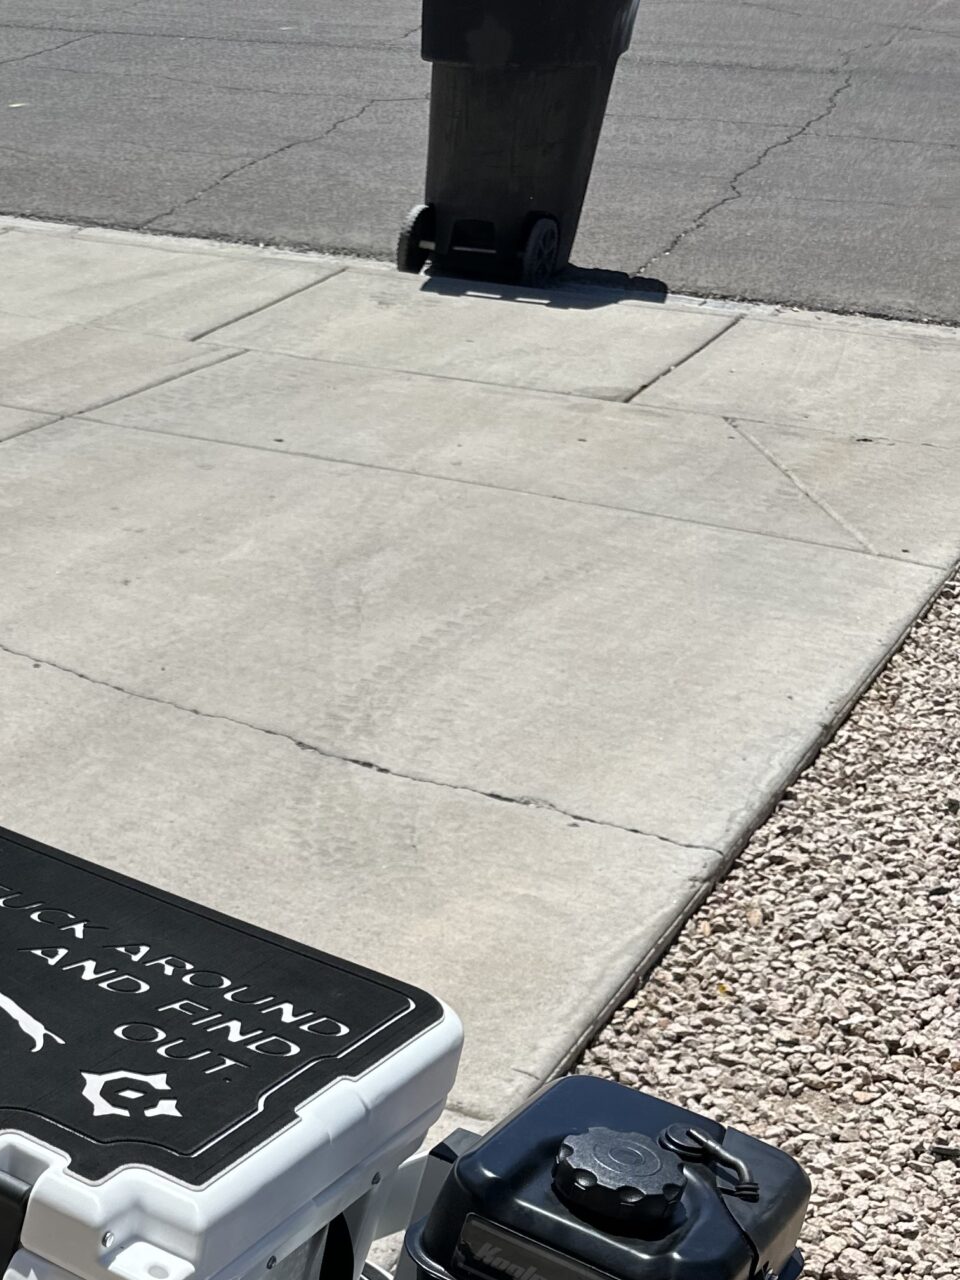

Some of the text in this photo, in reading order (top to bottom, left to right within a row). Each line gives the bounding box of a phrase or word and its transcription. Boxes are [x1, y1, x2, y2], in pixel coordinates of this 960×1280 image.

[17, 946, 301, 1056] AND FIND
[102, 944, 350, 1037] AROUND
